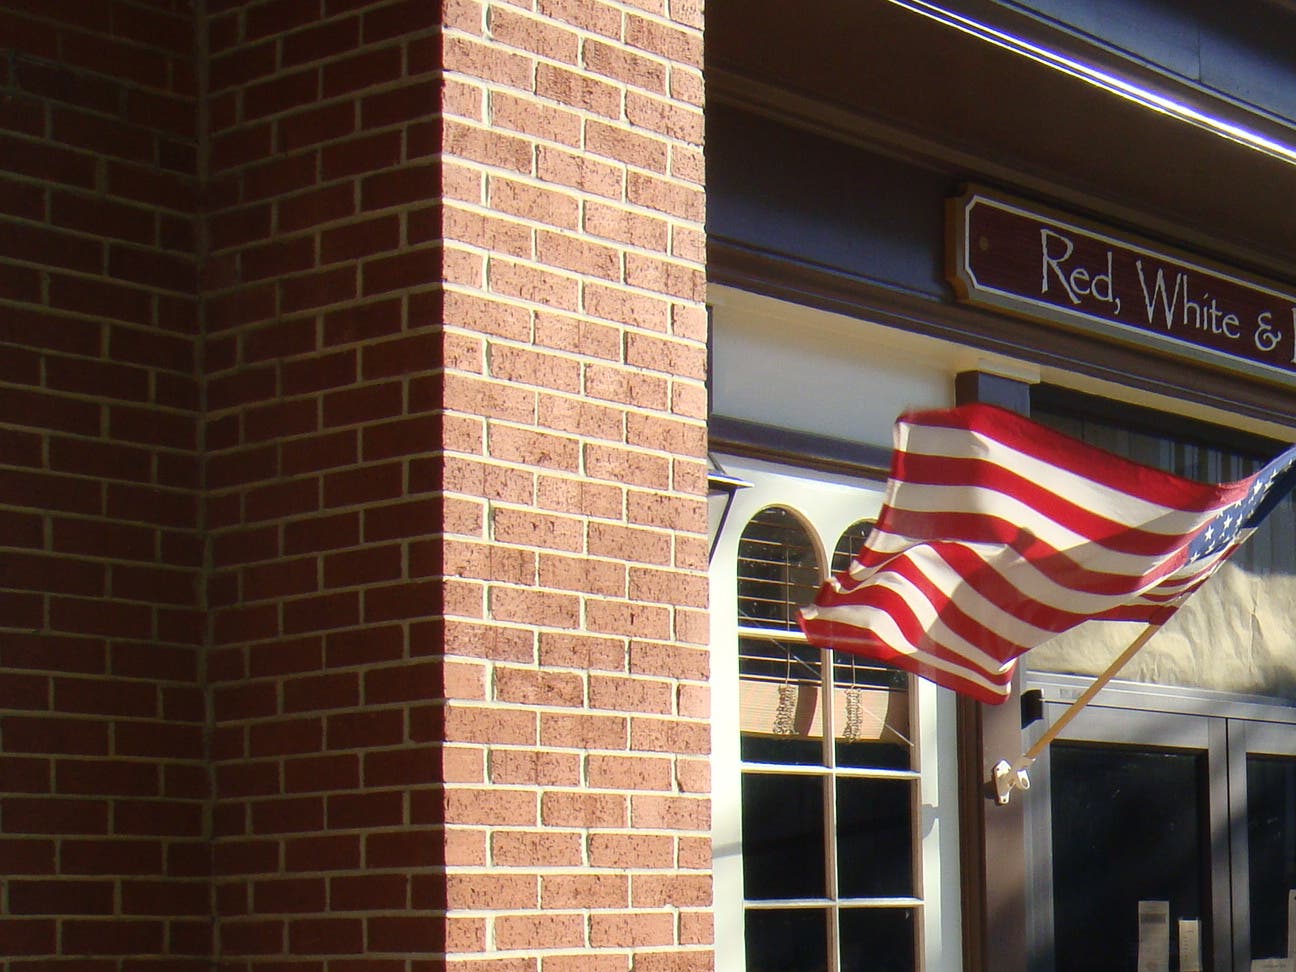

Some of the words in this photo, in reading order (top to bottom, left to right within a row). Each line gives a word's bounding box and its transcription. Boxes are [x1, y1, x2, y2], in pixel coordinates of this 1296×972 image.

[1040, 228, 1121, 315] Red,
[1135, 259, 1240, 339] White
[1253, 311, 1281, 351] &
